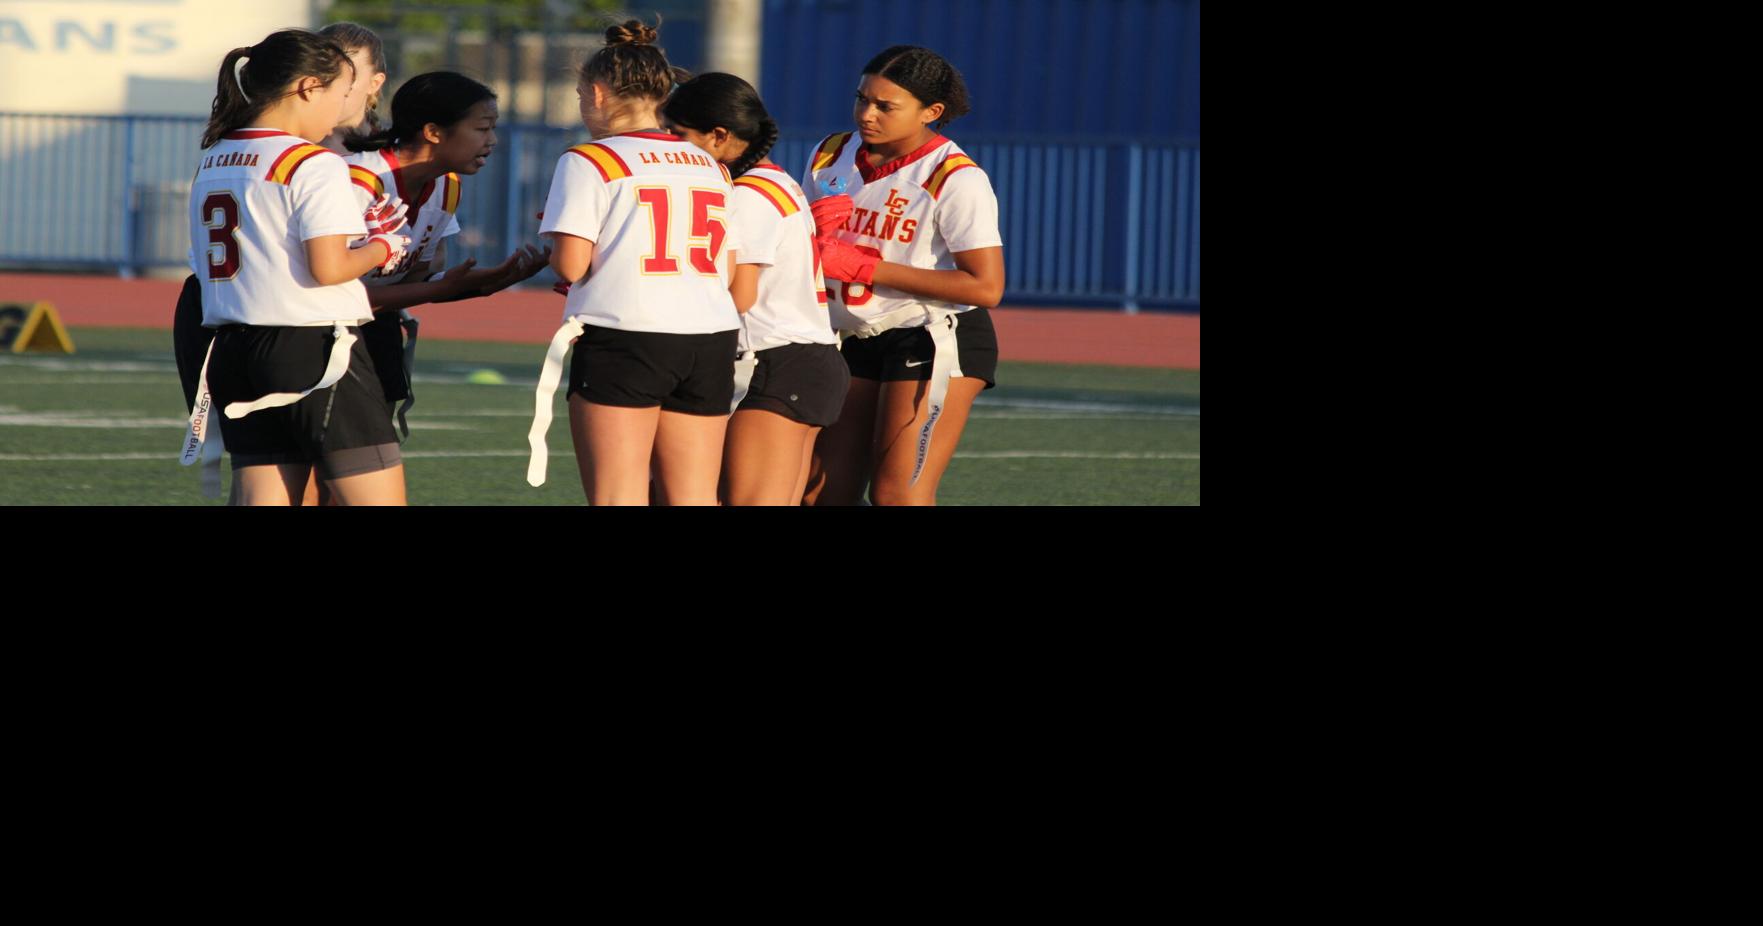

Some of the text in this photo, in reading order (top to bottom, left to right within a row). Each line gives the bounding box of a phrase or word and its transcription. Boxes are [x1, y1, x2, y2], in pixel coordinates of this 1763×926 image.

[216, 152, 259, 167] CAÑADA
[639, 152, 660, 164] LA
[202, 190, 241, 282] 3
[635, 185, 728, 277] 15
